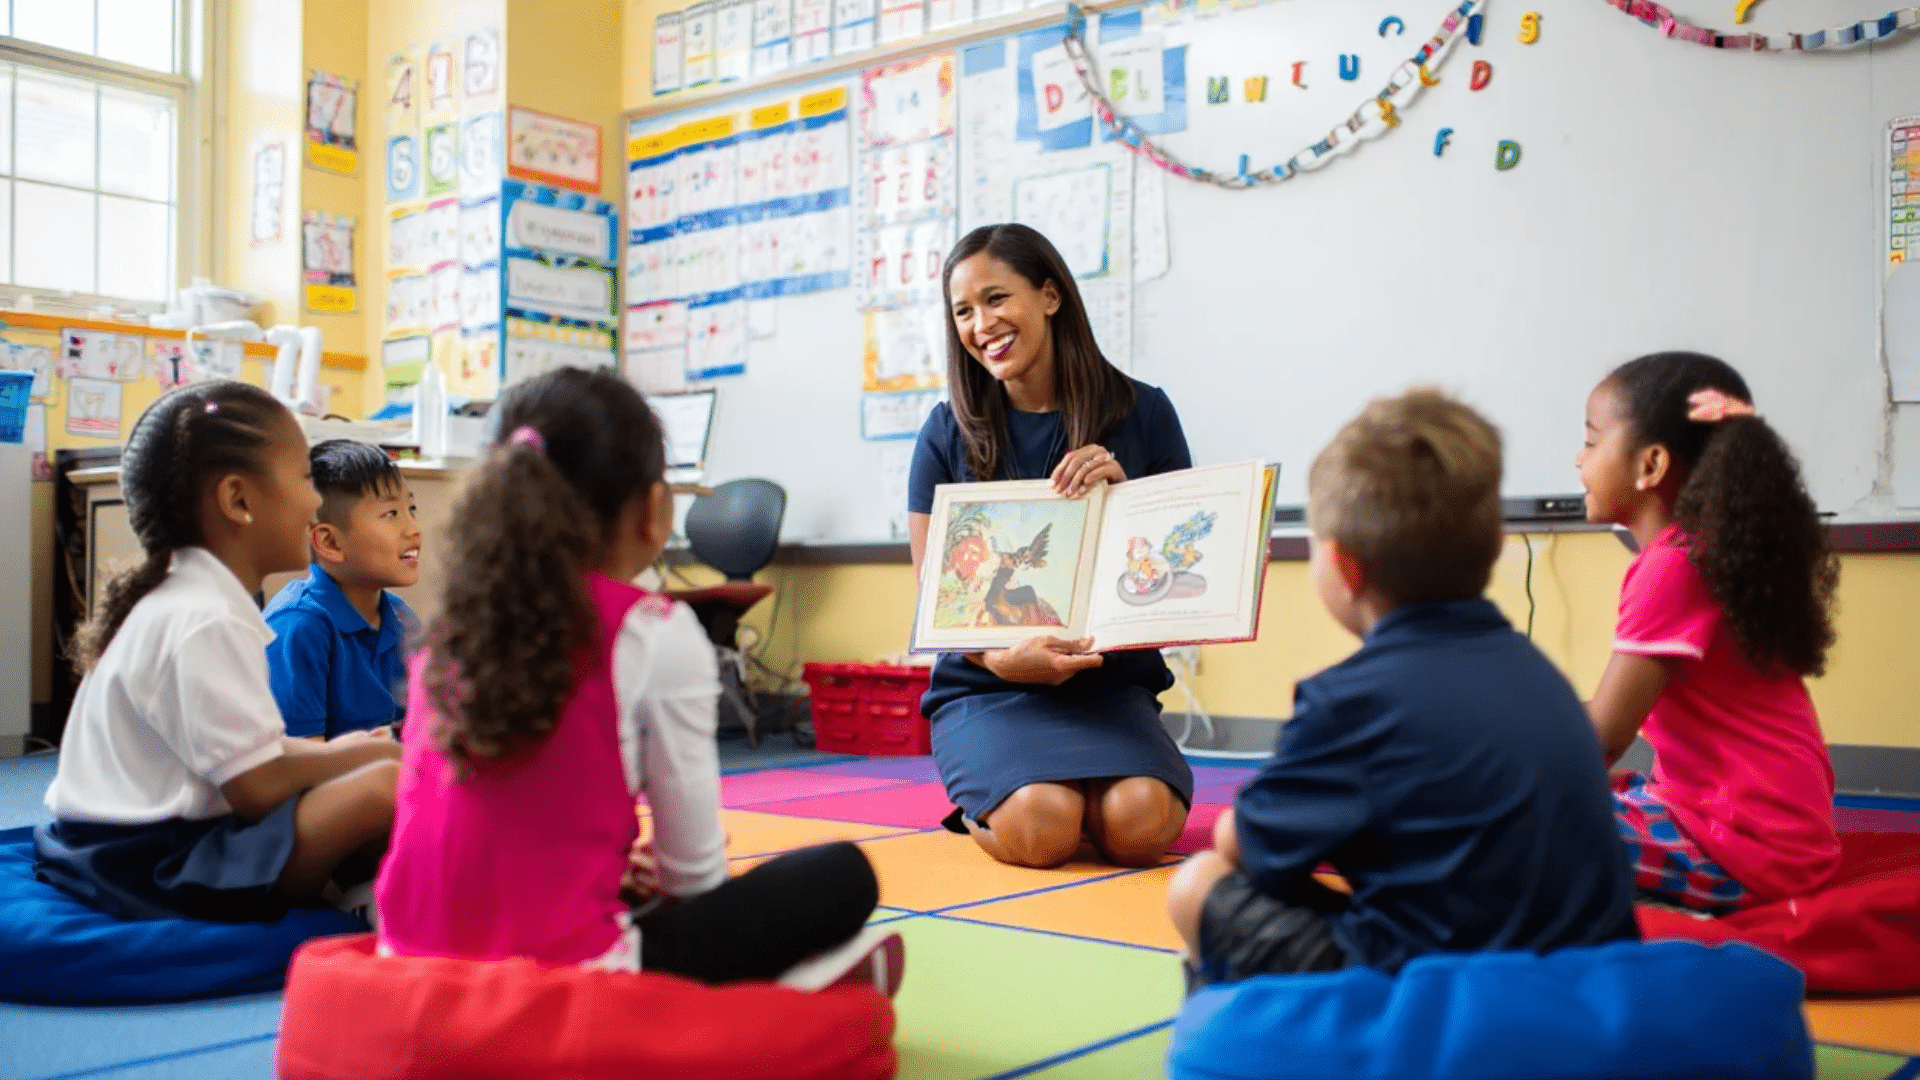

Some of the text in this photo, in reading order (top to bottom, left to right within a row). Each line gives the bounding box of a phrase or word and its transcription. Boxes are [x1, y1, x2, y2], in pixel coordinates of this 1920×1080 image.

[1338, 53, 1361, 82] U
[1469, 59, 1494, 92] D
[1495, 138, 1522, 173] D
